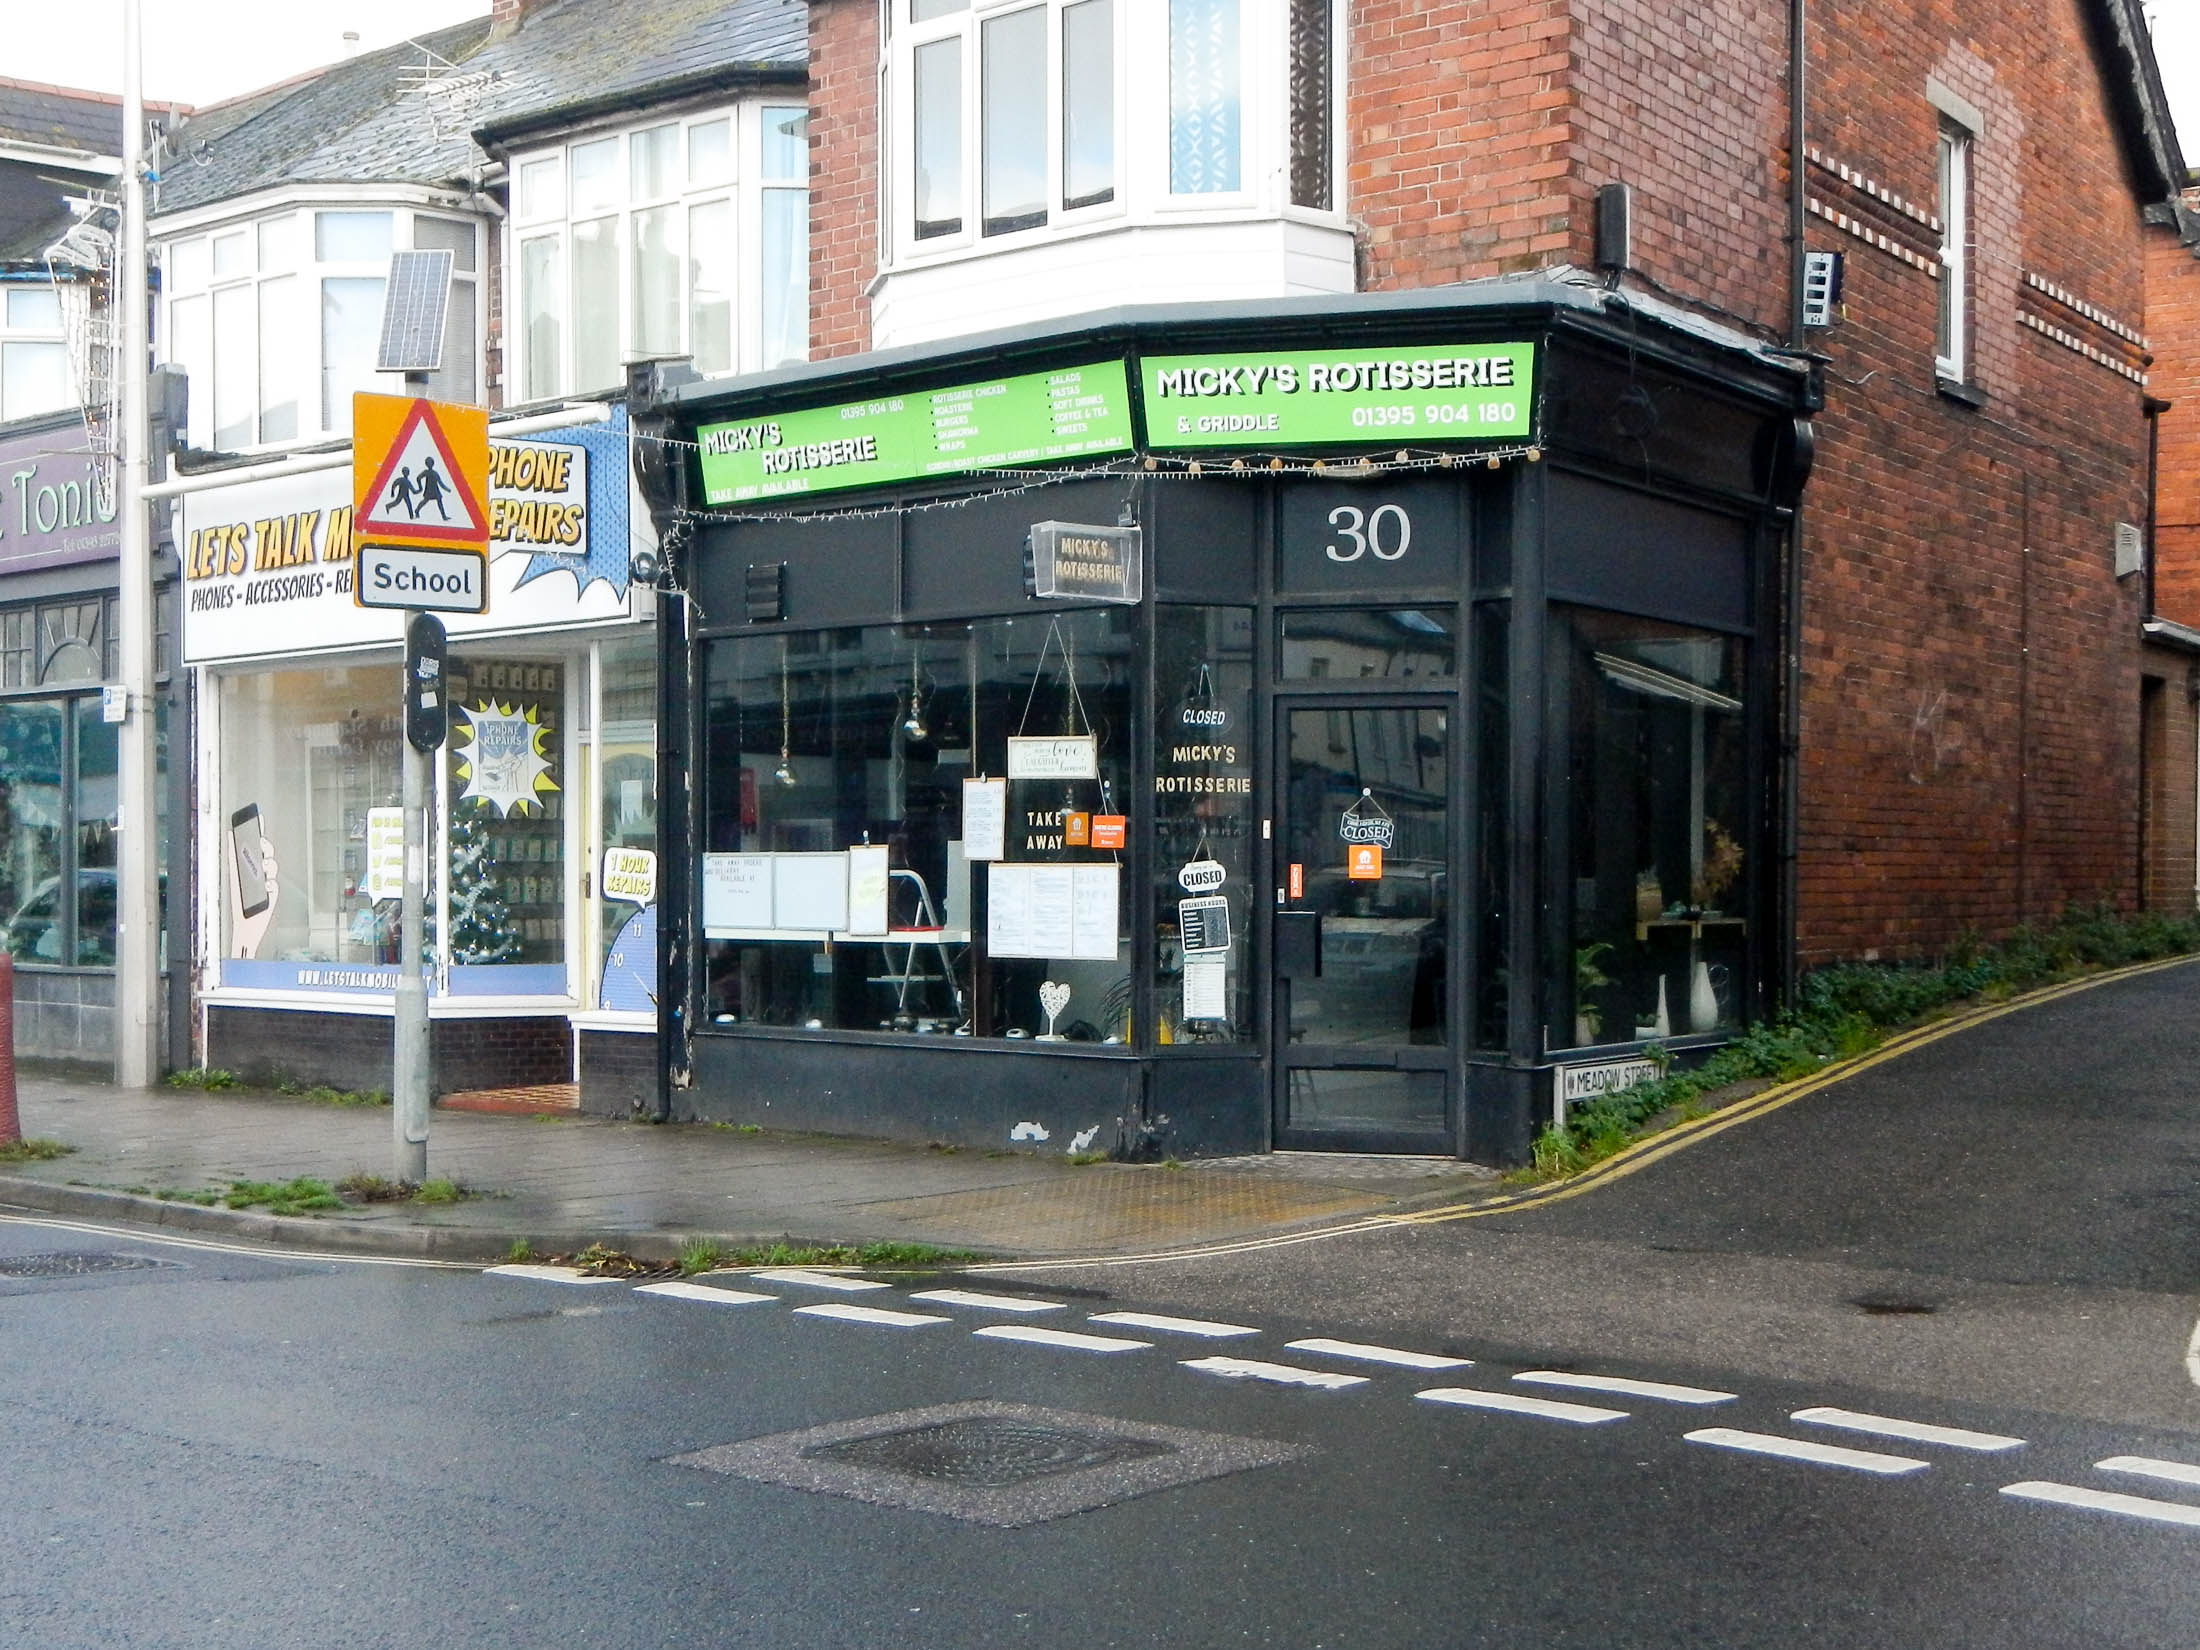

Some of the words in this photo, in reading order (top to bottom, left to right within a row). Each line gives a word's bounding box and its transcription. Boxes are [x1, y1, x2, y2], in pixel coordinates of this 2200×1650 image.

[1157, 364, 1300, 397] MICKY'S
[1308, 356, 1513, 393] ROTISSERIE
[840, 404, 866, 419] 01395
[868, 402, 886, 416] 904
[888, 399, 904, 413] 180
[1352, 406, 1416, 427] 01395
[1425, 404, 1469, 424] 904
[1478, 402, 1516, 423] 180
[1178, 415, 1192, 433] &
[1198, 413, 1280, 432] GRIDDLE
[704, 422, 783, 456] MICKY'S
[762, 435, 877, 475] ROTISSERIE
[490, 498, 584, 547] EPAIRS
[1326, 504, 1411, 562] 30
[187, 522, 248, 581] LETS
[254, 510, 321, 572] TALK
[1061, 537, 1109, 557] MICKY'S
[374, 562, 472, 594] School
[1055, 560, 1122, 584] ROTISSERIE
[191, 584, 235, 613] PHONES
[245, 572, 325, 606] ACCESSORIES
[1182, 708, 1226, 725] CLOSED
[483, 735, 522, 746] REPAIRS
[1173, 745, 1236, 763] MICKY'S
[1156, 776, 1251, 793] ROTISSERIE
[1027, 811, 1062, 827] TAKE
[1026, 835, 1063, 850] AWAY
[1344, 825, 1390, 840] CLOSED
[620, 855, 650, 874] HOUR
[607, 875, 650, 897] REPAIRS
[1184, 870, 1222, 887] CLOSED
[633, 923, 642, 937] 11
[613, 953, 624, 967] 10
[1576, 1066, 1620, 1093] MEADOW
[1624, 1064, 1658, 1088] STREET
